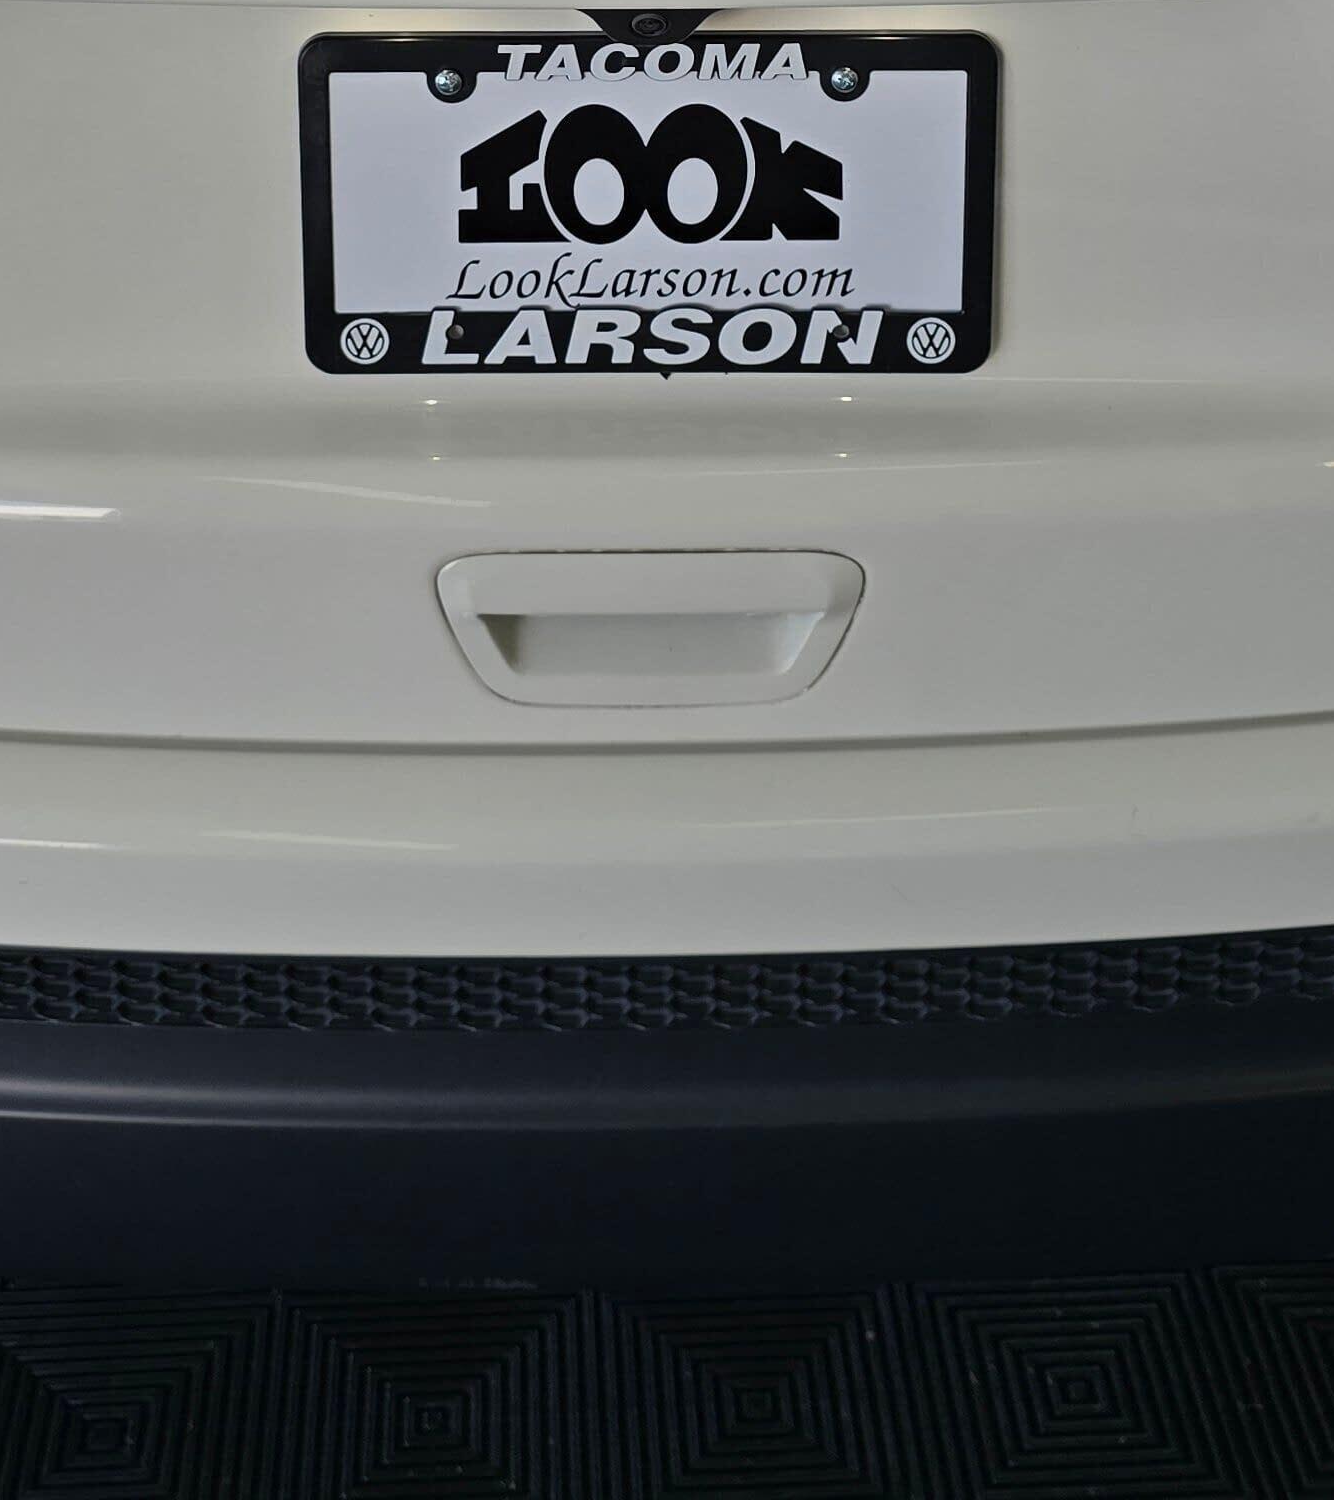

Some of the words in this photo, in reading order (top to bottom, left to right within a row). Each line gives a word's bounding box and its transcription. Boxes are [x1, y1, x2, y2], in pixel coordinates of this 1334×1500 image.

[497, 42, 809, 82] TACOMA
[457, 102, 844, 246] LOOK
[446, 252, 855, 307] LookLarson.com
[420, 307, 885, 366] LARSON
